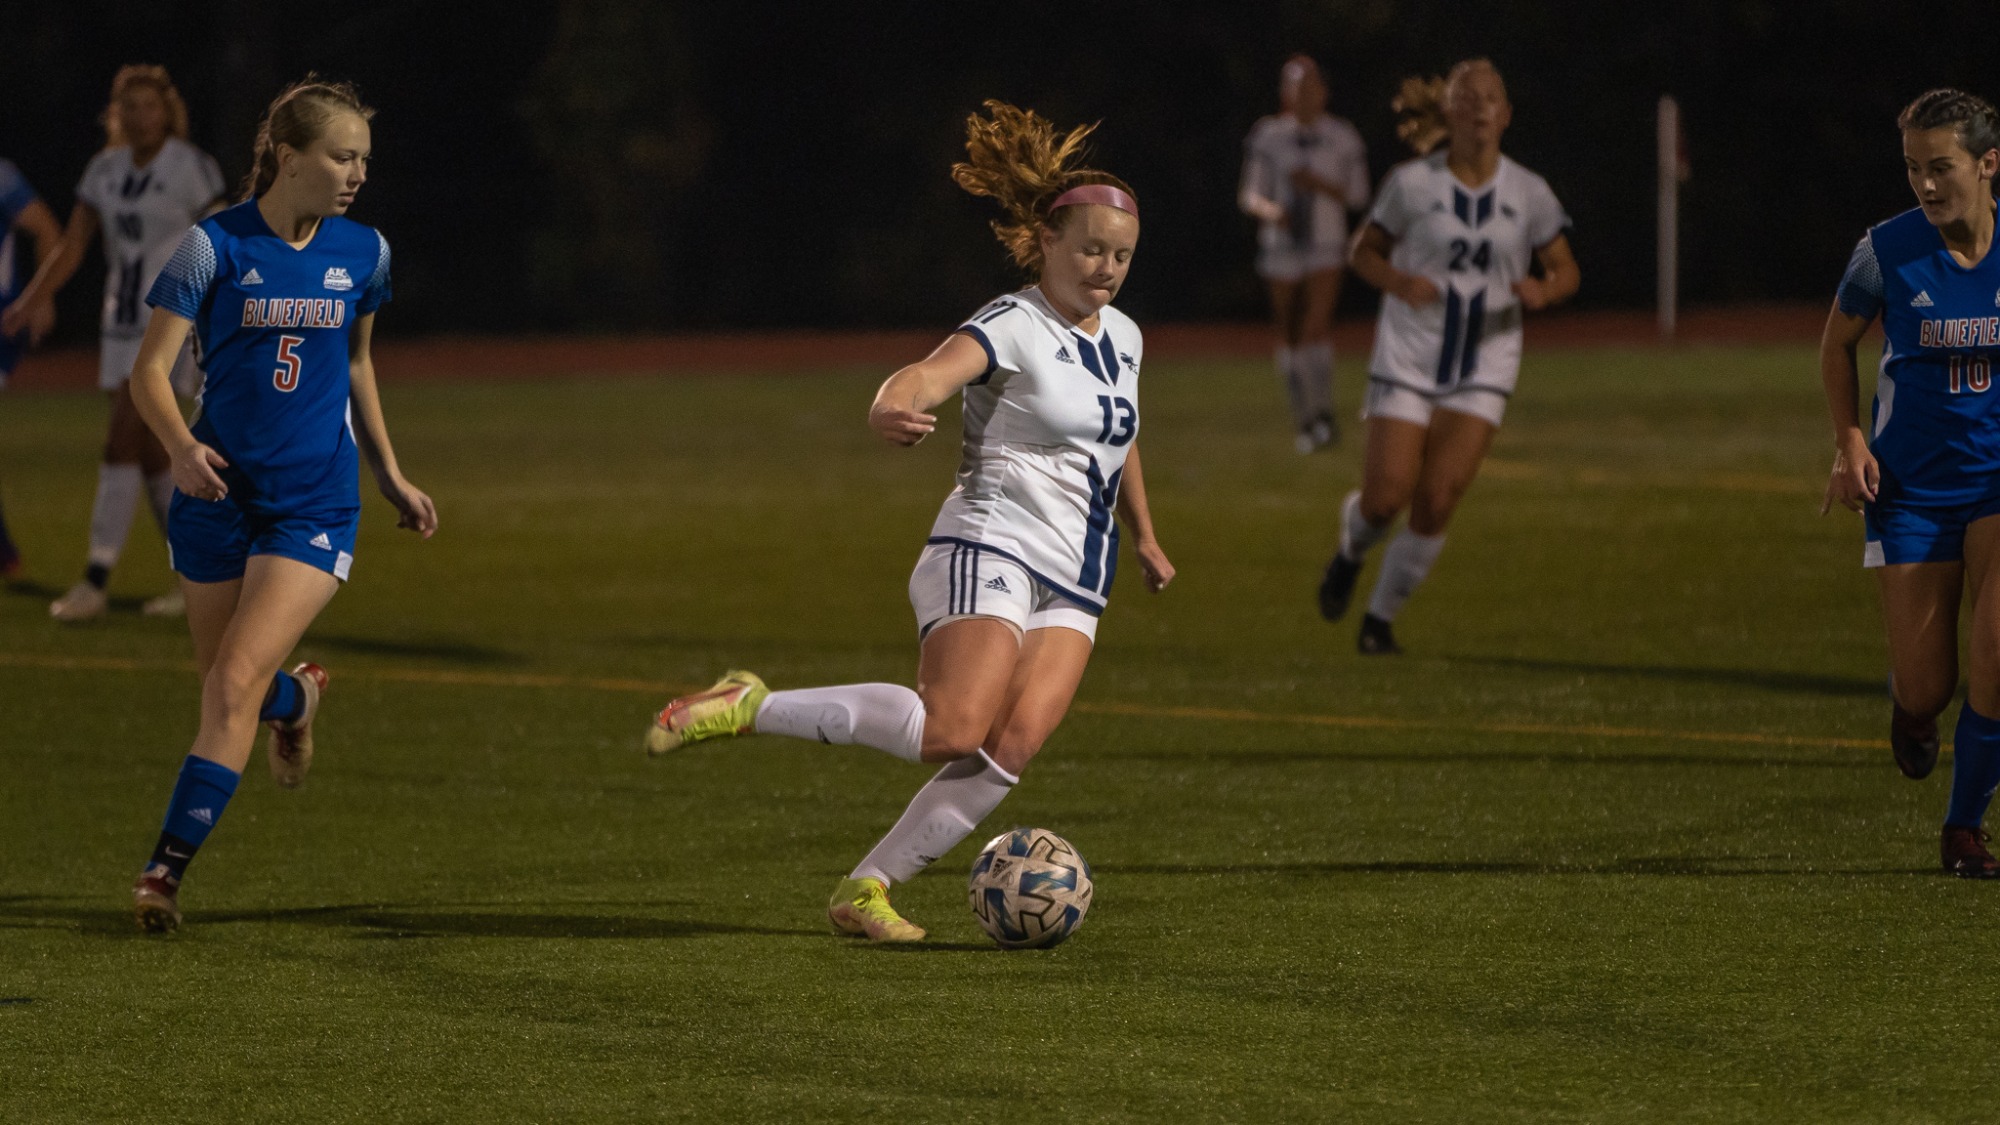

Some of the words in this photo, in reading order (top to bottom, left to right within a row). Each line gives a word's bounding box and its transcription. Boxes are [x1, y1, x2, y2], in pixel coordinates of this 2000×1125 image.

[1448, 238, 1492, 274] 24
[241, 297, 345, 328] BLUEFIELD
[1919, 316, 2000, 348] BLUEFIE
[272, 334, 305, 393] 5
[1949, 354, 1991, 394] 10
[1096, 394, 1137, 447] 13
